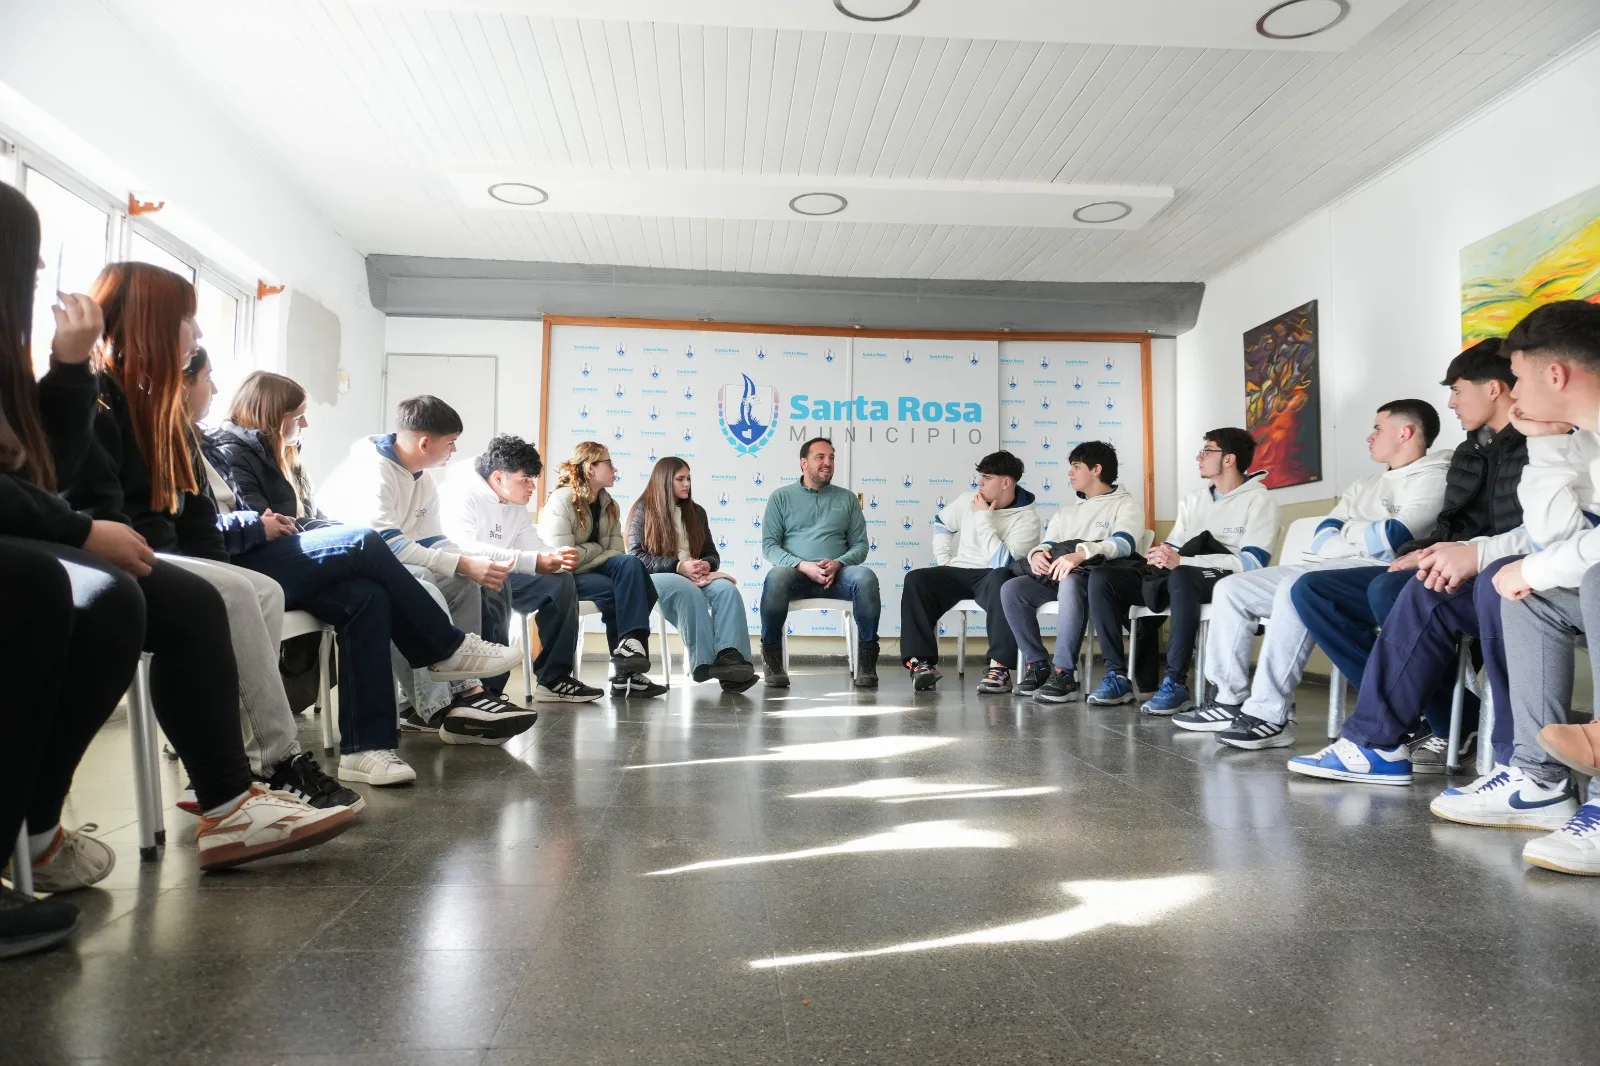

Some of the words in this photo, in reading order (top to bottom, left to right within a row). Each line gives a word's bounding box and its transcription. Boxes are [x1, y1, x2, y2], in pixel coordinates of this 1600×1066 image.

[790, 394, 888, 420] Santa
[898, 396, 982, 422] Rosa
[790, 426, 982, 444] MUNICIPIO
